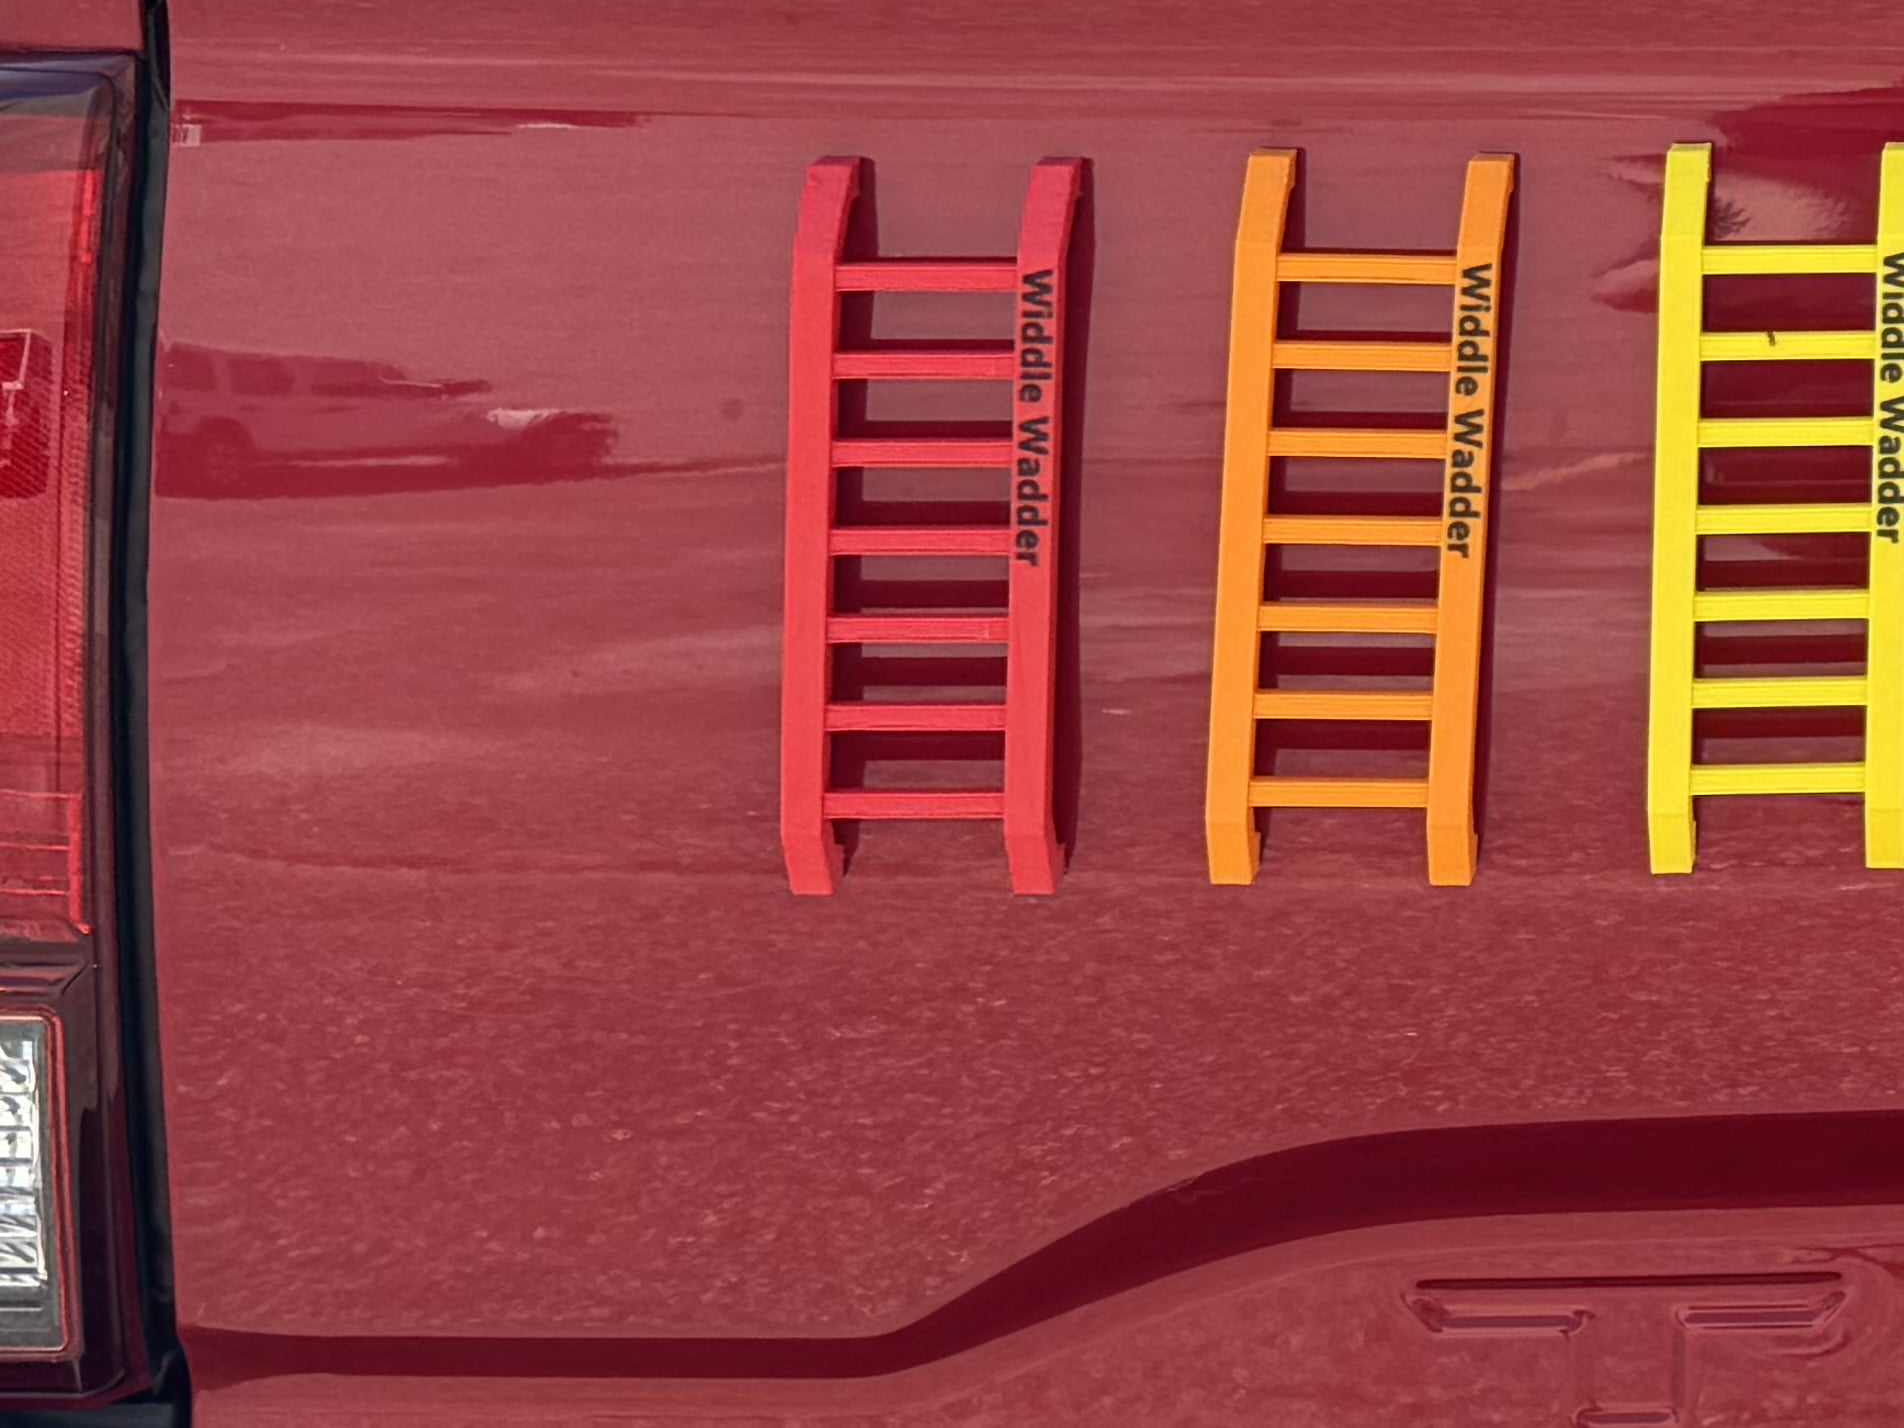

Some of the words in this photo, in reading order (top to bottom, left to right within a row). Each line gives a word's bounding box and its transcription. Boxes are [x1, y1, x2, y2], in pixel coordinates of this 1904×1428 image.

[1019, 268, 1054, 404] Widdle
[1454, 263, 1493, 396] Widdle
[1015, 415, 1050, 568] Wadder
[1447, 409, 1485, 559] Wadder
